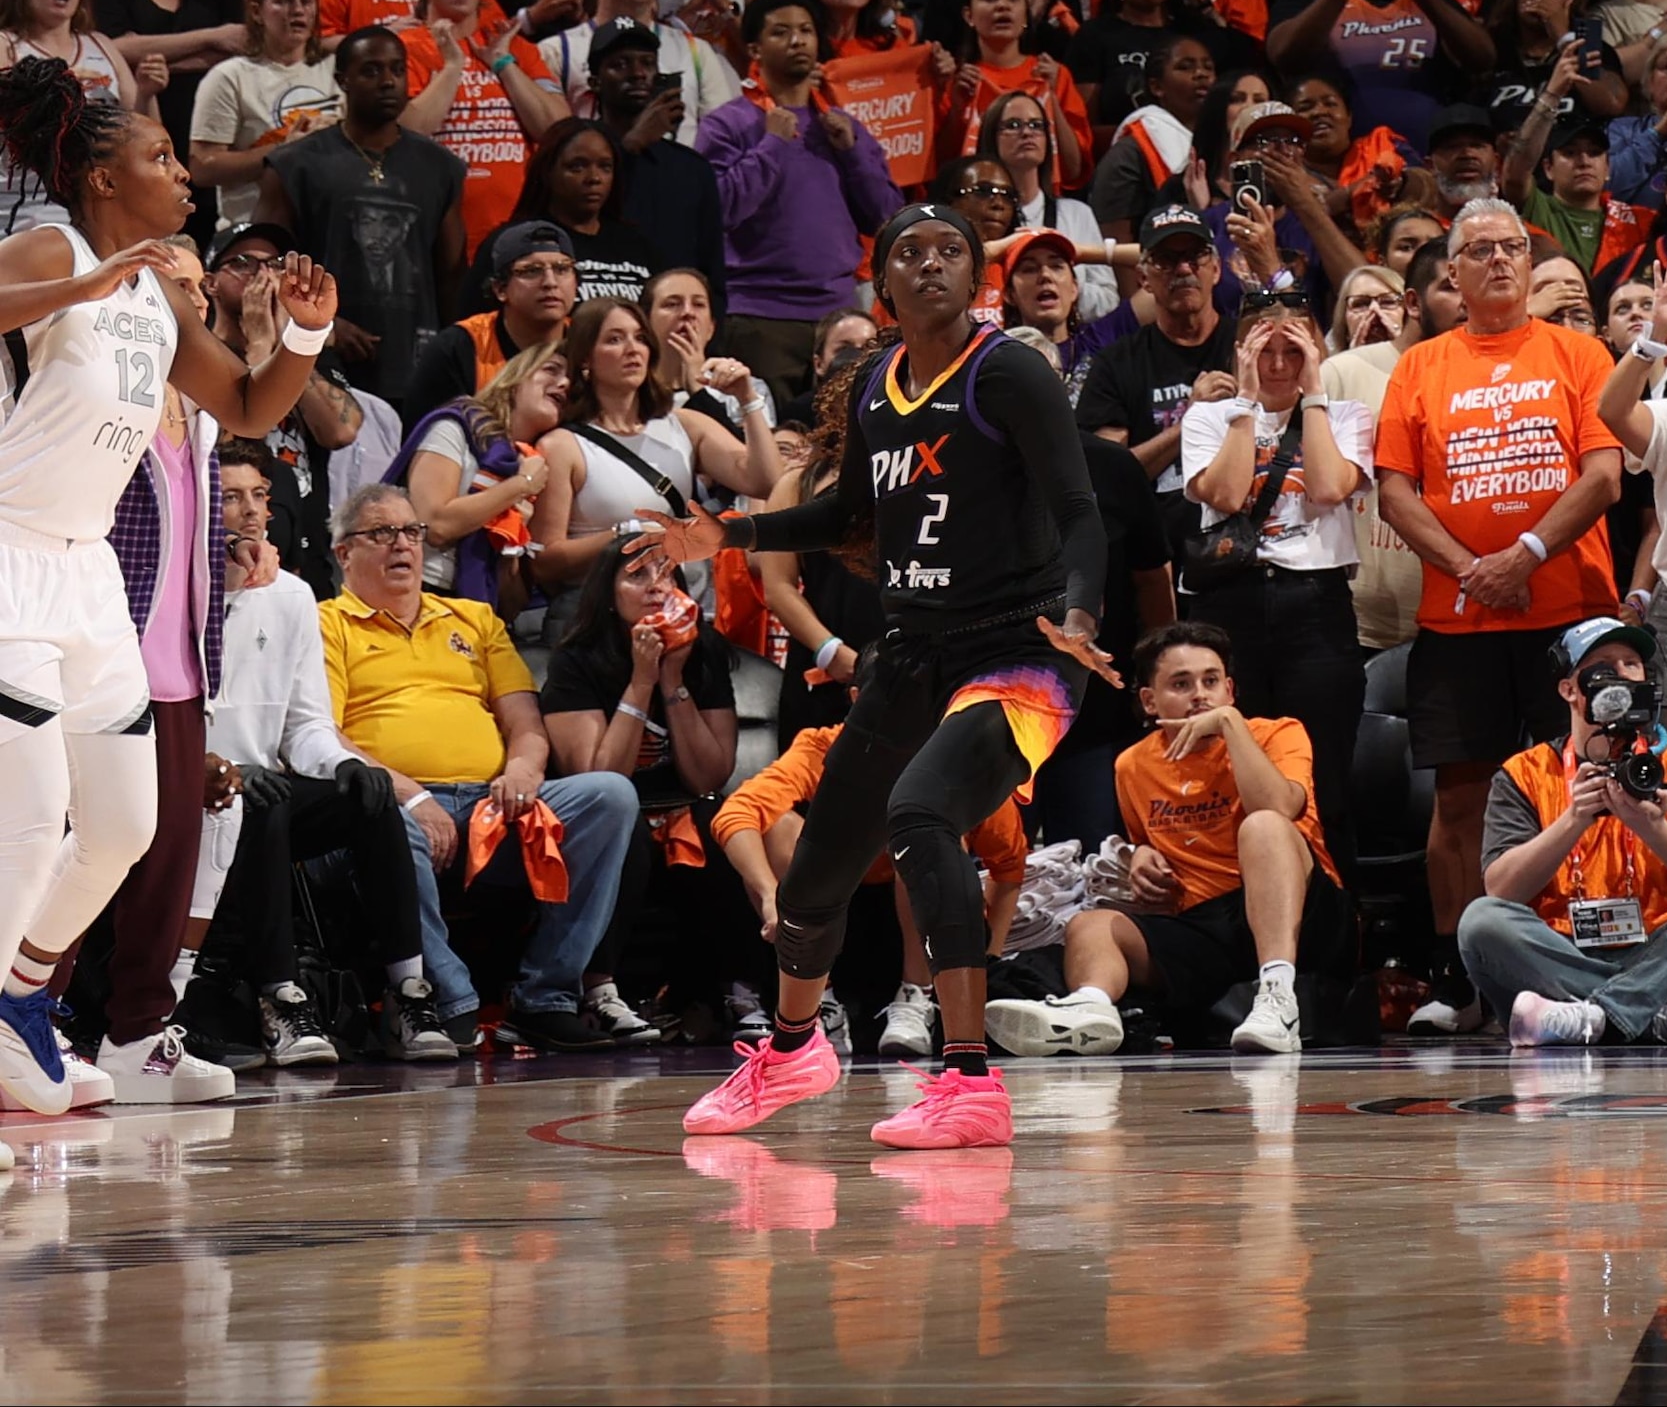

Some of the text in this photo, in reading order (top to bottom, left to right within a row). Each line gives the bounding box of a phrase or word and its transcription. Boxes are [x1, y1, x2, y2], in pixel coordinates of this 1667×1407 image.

[1340, 16, 1424, 40] Phoenix
[1380, 37, 1429, 68] 25
[93, 306, 168, 348] ACES
[114, 347, 157, 406] 12
[1449, 379, 1556, 413] MERCURY
[1494, 407, 1513, 423] VS
[93, 417, 144, 464] ring
[1447, 418, 1559, 453] NEW YORK
[870, 433, 951, 499] PHX
[1446, 442, 1568, 477] MINNESOTA
[1450, 466, 1568, 505] EVERYBODY
[916, 493, 950, 546] 2
[904, 560, 952, 591] fry's
[1147, 792, 1232, 819] Phoenix
